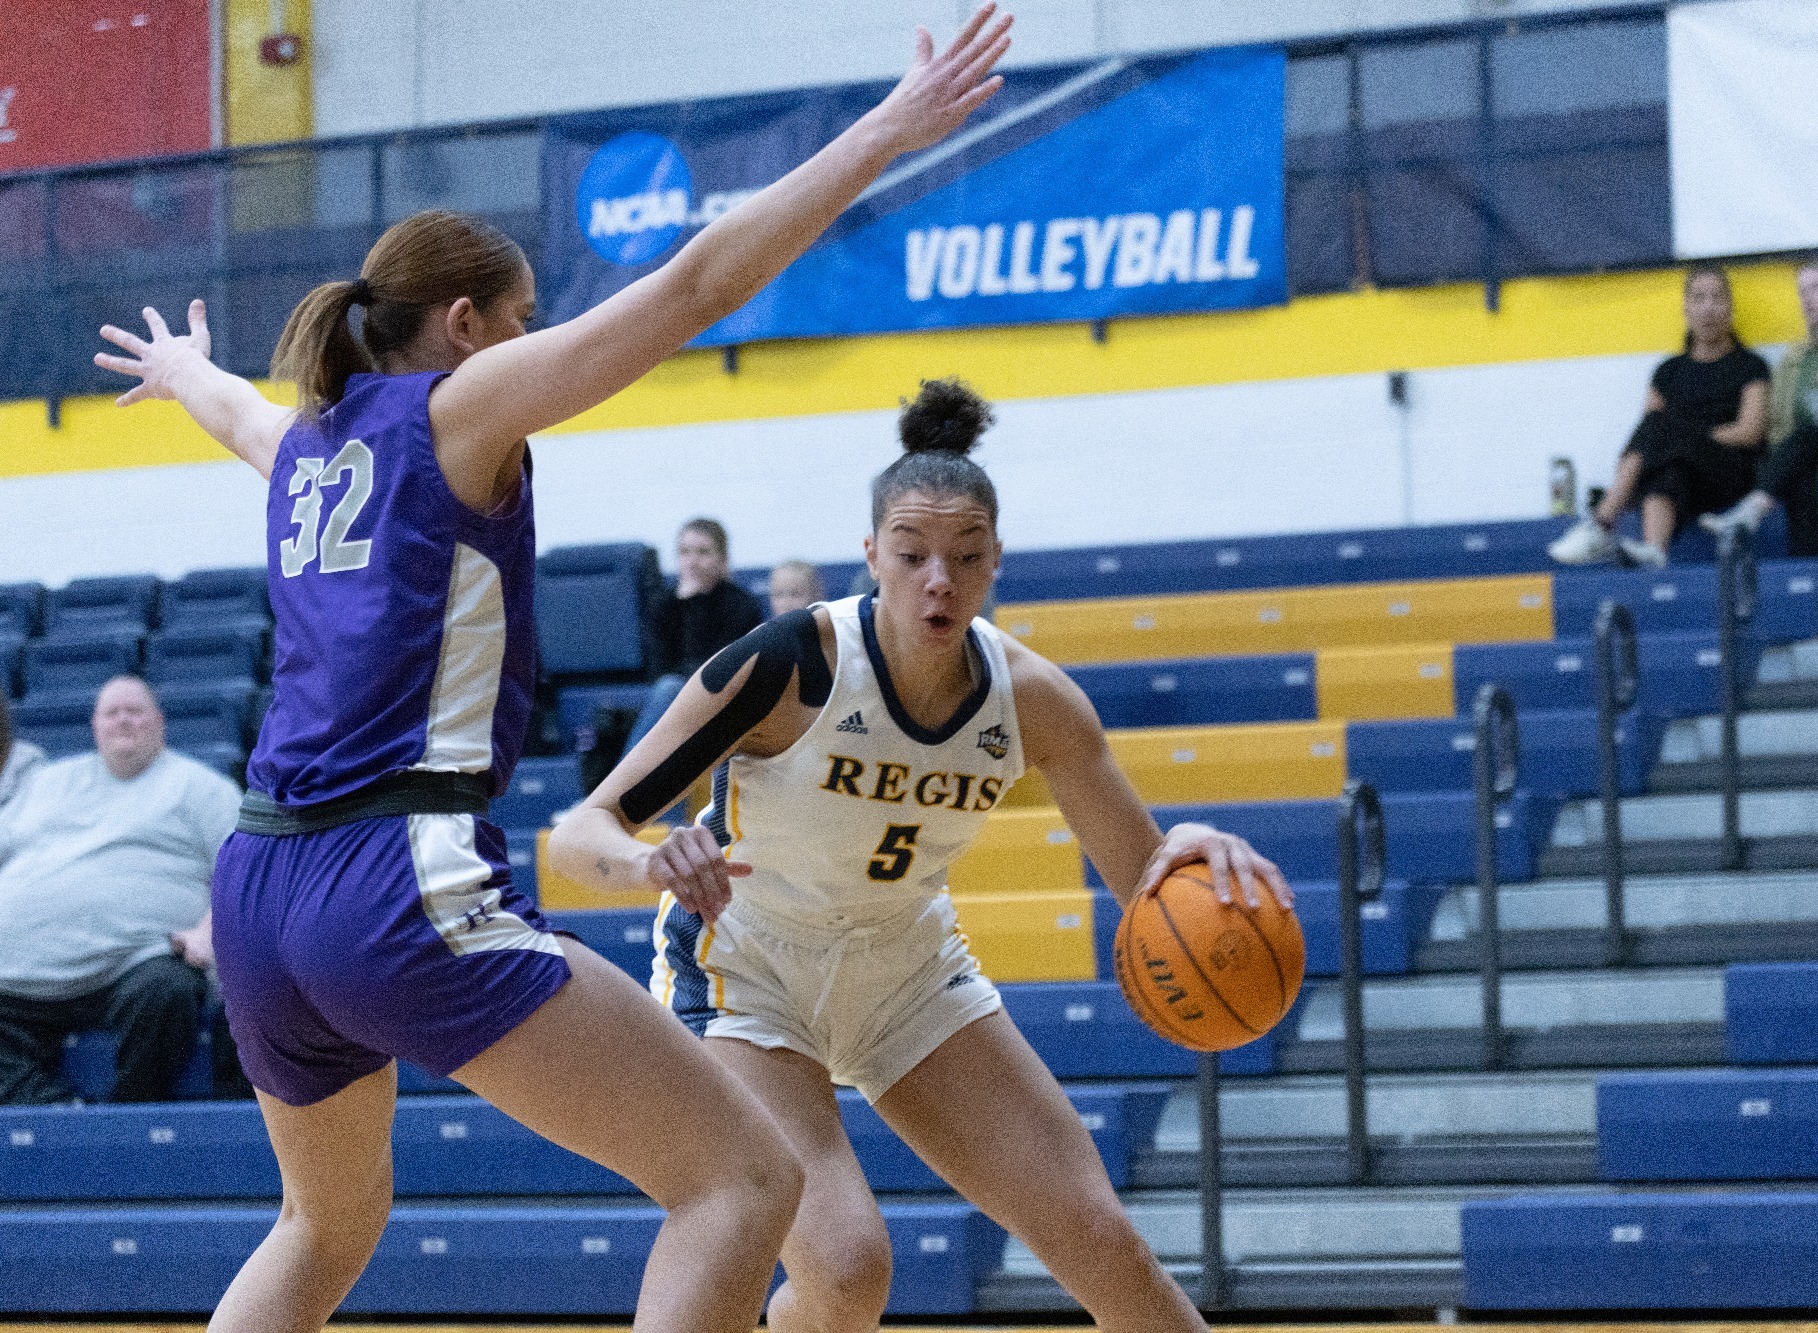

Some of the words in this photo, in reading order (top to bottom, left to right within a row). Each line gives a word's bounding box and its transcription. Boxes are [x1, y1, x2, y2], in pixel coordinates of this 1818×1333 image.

[905, 205, 1260, 301] VOLLEYBALL
[279, 438, 374, 579] 32
[835, 723, 869, 736] adidas
[818, 752, 1005, 813] REGIS
[866, 822, 923, 884] 5
